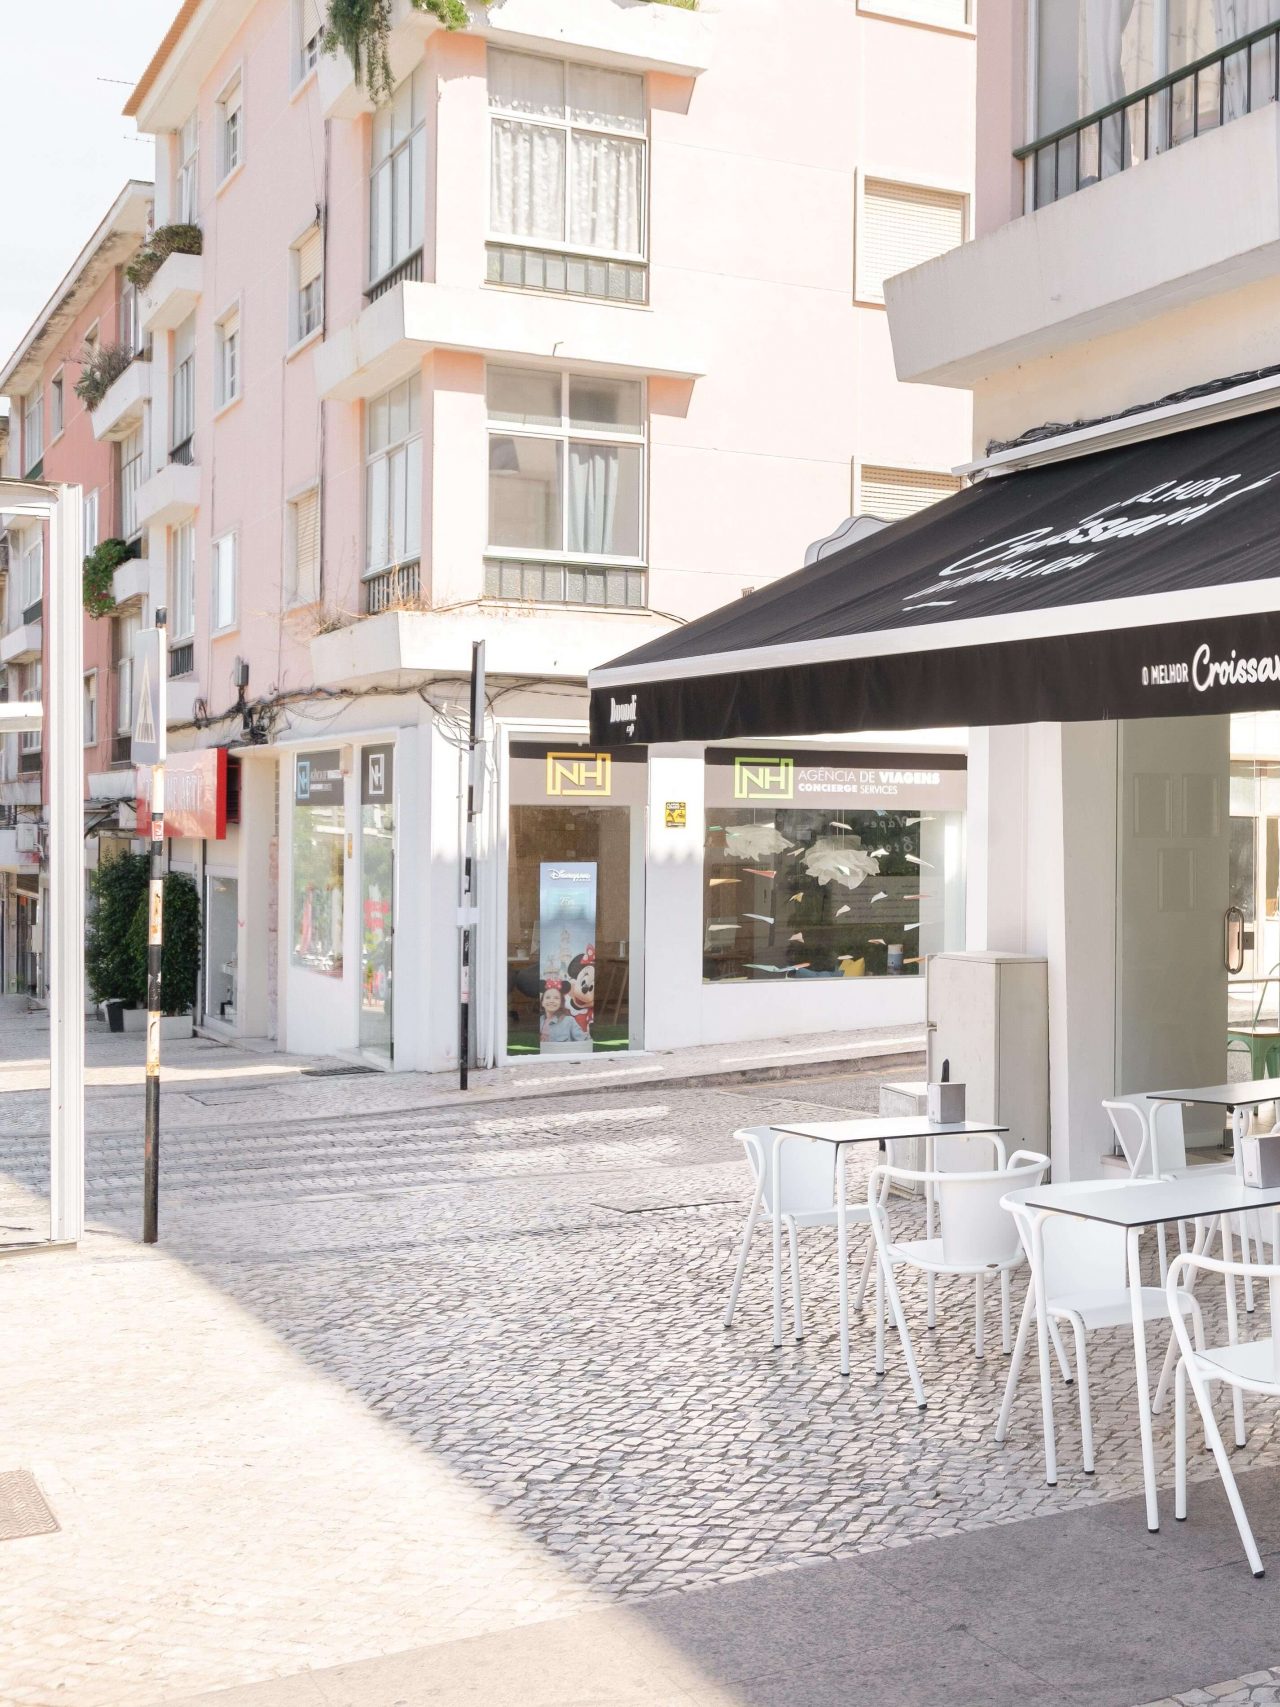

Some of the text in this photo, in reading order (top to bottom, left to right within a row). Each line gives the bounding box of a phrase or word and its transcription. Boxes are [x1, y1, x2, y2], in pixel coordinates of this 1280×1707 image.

[1141, 666, 1149, 686] O
[1151, 663, 1189, 685] MELHOR
[549, 756, 608, 793] NH
[737, 760, 790, 796] NH
[798, 767, 941, 785] AGÊNCIA DE VIAGENS
[798, 783, 898, 795] CONCIERGE SERVICES
